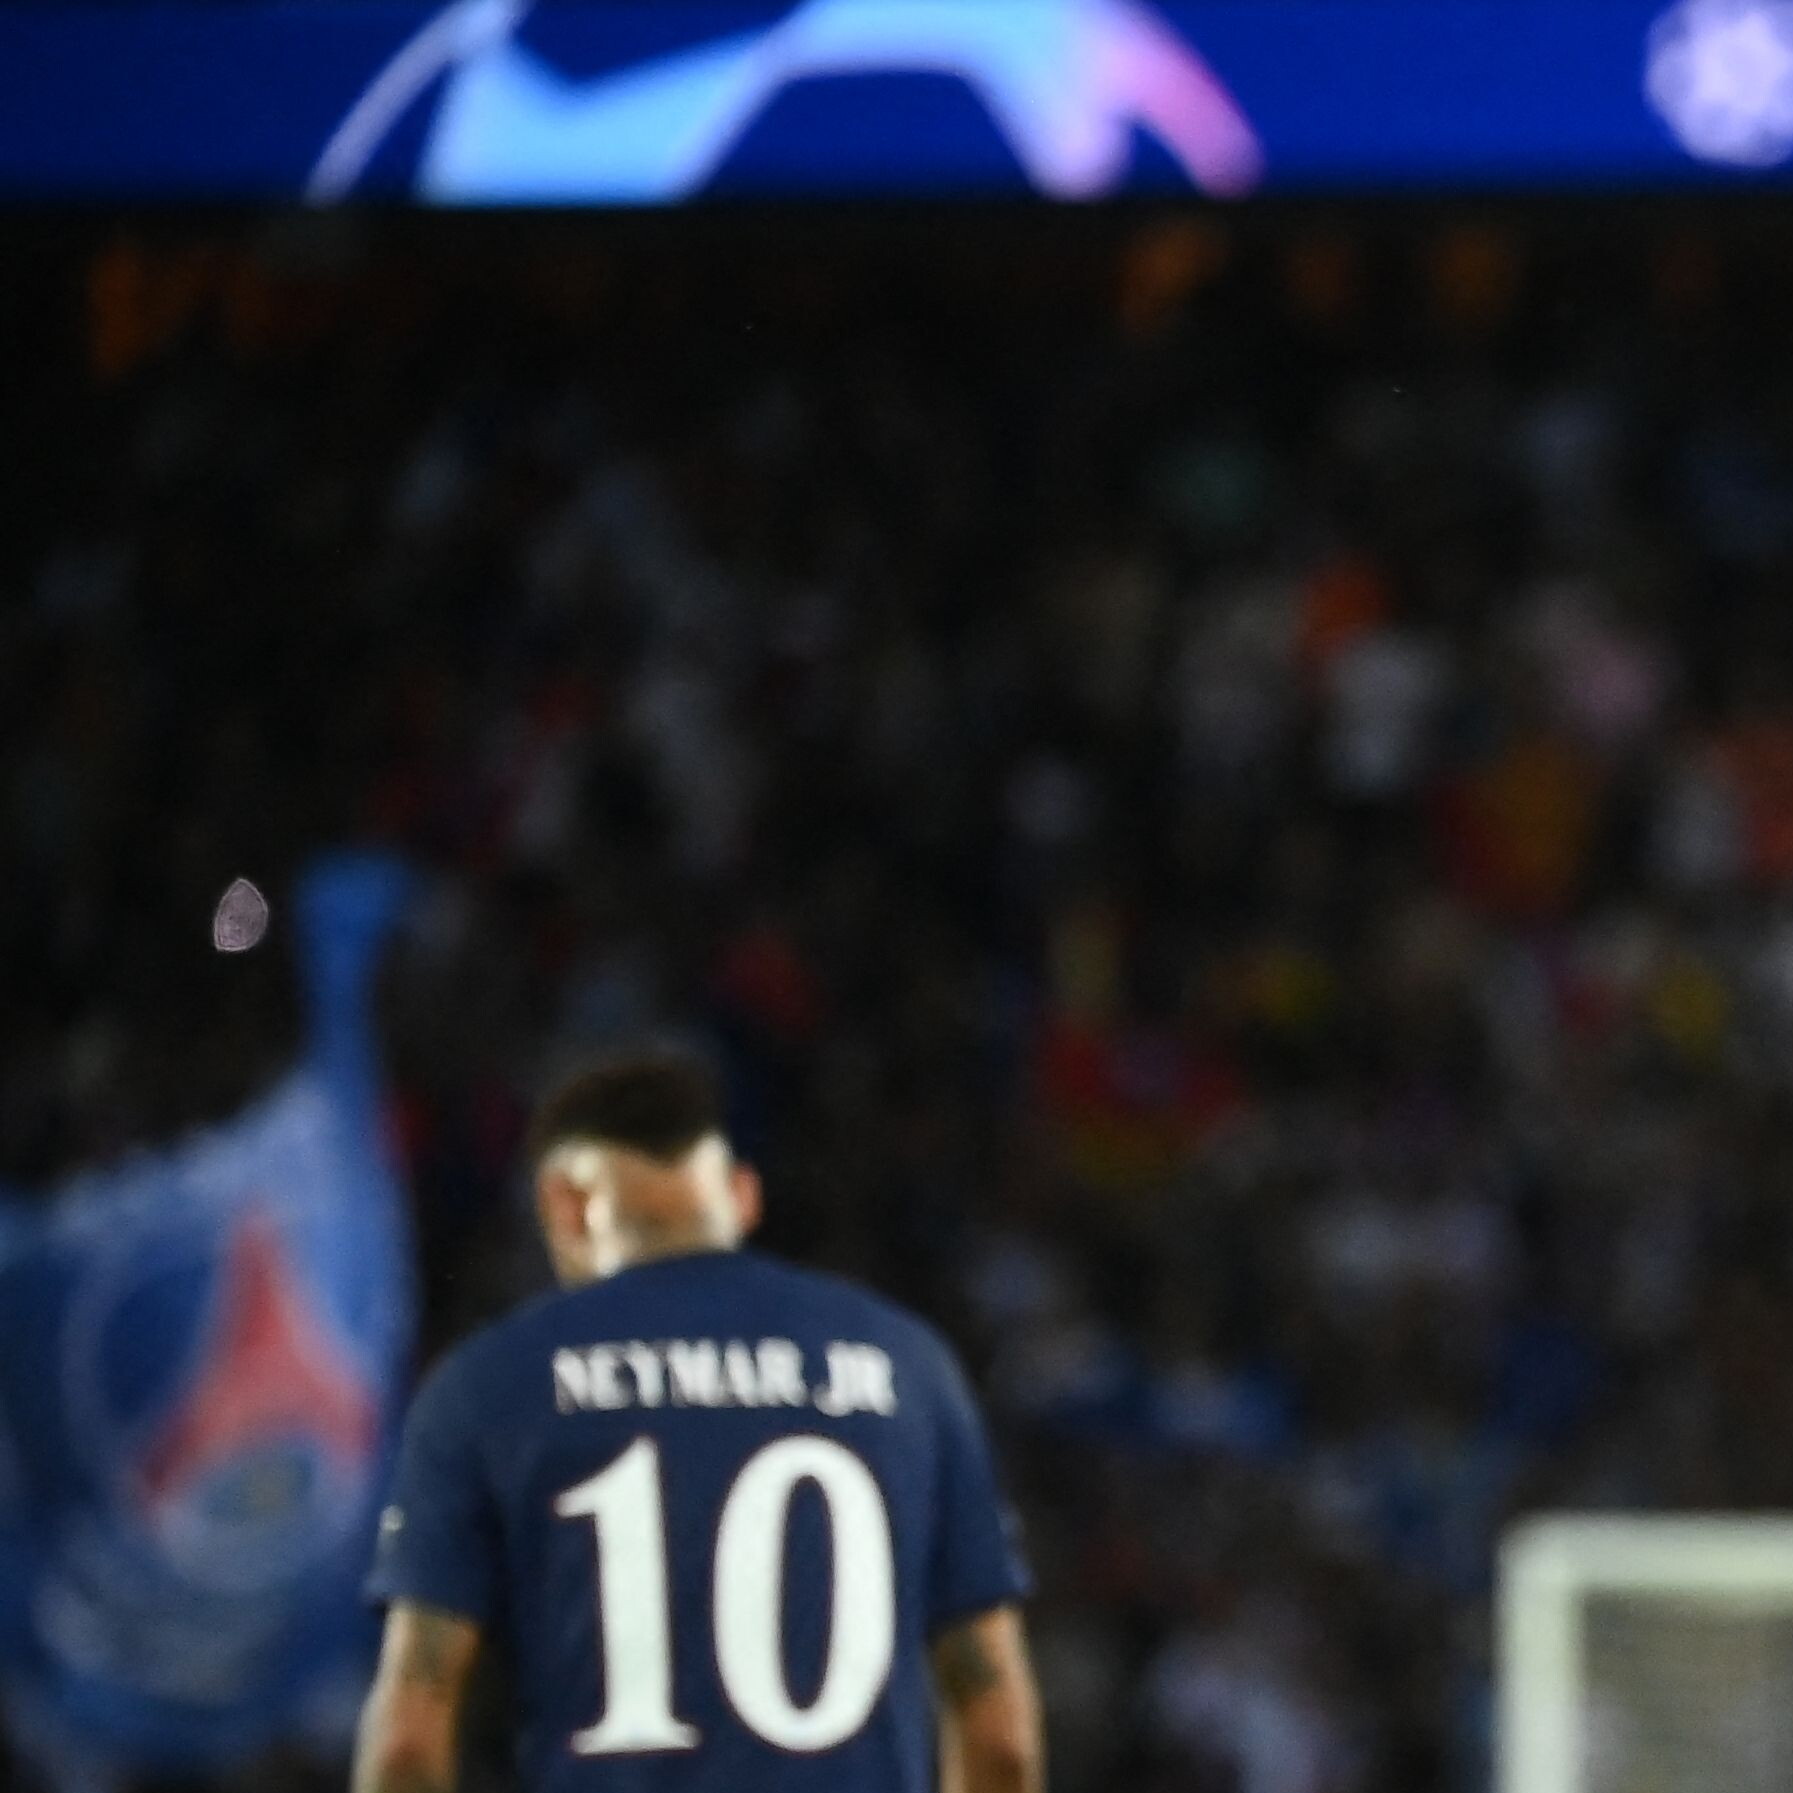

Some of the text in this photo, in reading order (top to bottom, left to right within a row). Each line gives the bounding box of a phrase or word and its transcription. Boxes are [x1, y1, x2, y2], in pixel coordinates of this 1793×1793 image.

[553, 1337, 899, 1418] NEYMAR JR
[553, 1435, 897, 1756] 10
